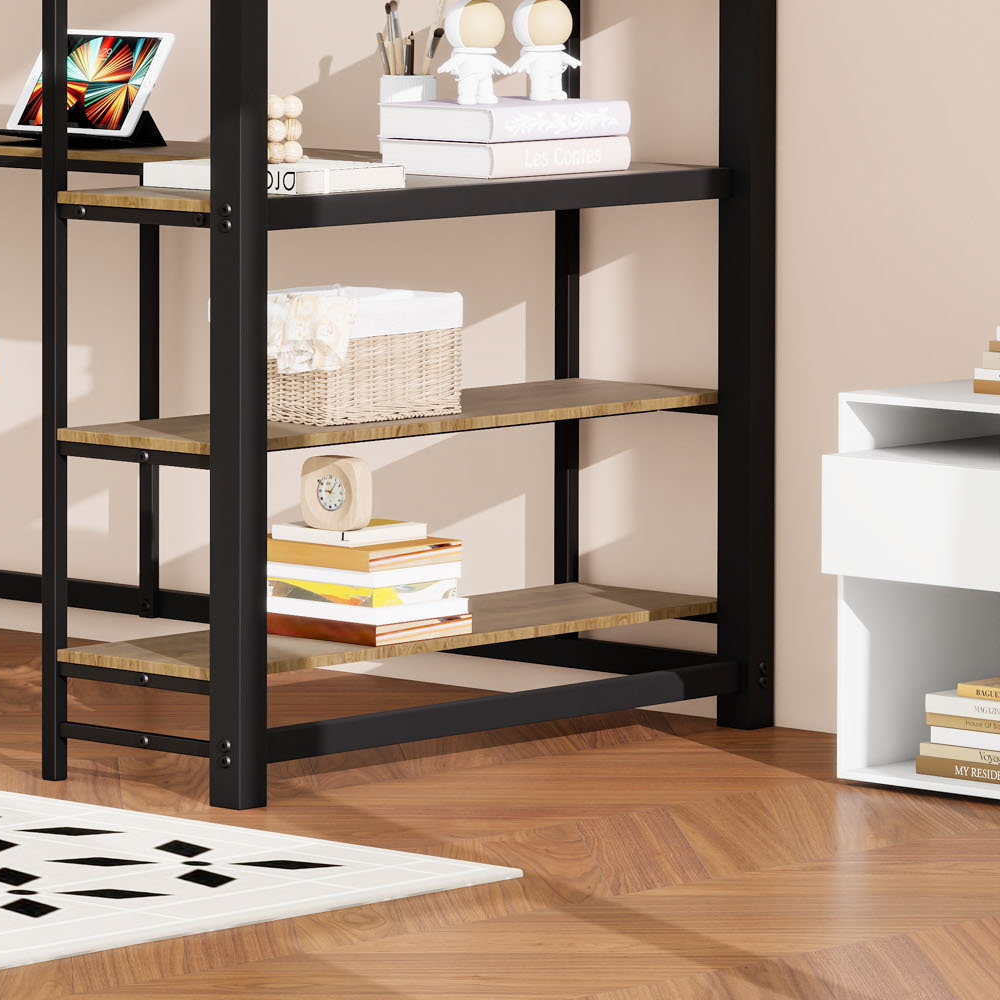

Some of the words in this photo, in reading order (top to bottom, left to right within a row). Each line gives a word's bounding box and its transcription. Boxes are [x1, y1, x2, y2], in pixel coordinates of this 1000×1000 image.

[524, 148, 549, 169] Les
[553, 146, 602, 167] Contes
[976, 688, 1000, 698] BAGUE
[954, 765, 970, 776] MY
